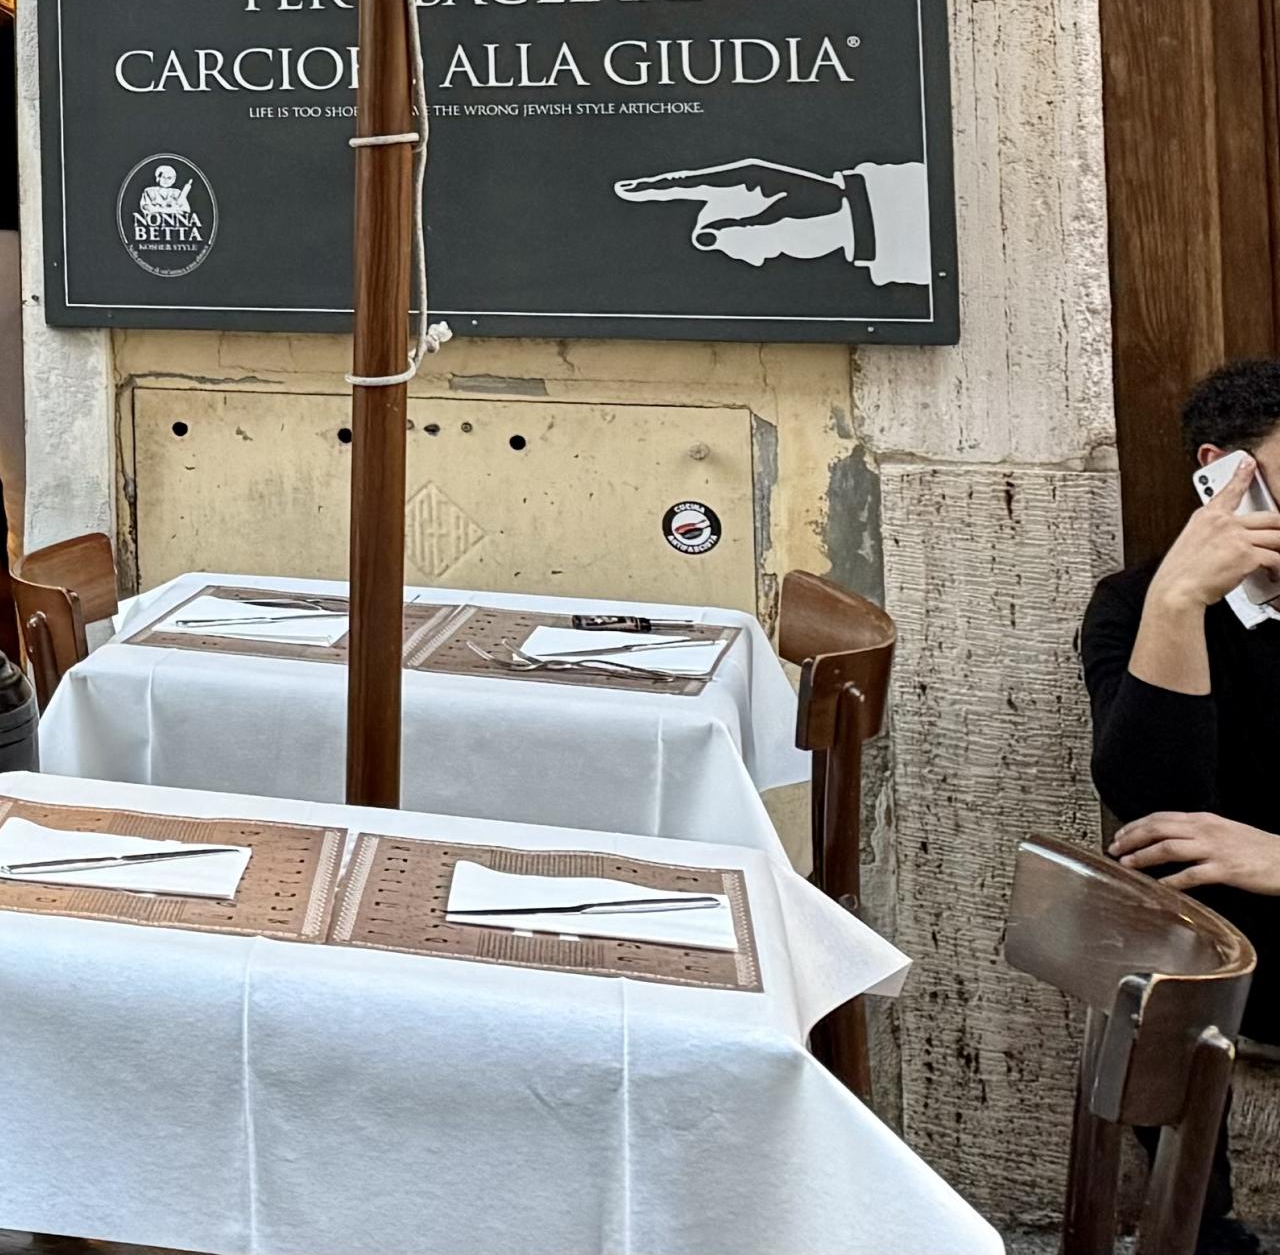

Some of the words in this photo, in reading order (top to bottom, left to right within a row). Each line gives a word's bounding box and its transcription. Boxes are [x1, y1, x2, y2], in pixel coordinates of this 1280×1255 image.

[114, 45, 360, 94] CARCIO
[439, 40, 591, 89] ALLA
[248, 106, 274, 118] LIFE
[277, 106, 289, 118] IS
[292, 105, 322, 118] TOO
[325, 105, 359, 117] SHO
[433, 104, 461, 116] THE
[463, 104, 519, 116] WRONG
[523, 103, 573, 117] JEWISH
[576, 102, 616, 115] STYLE
[618, 101, 705, 115] ARTICHOKE.
[132, 212, 203, 227] NONNA
[134, 226, 204, 241] BETTA
